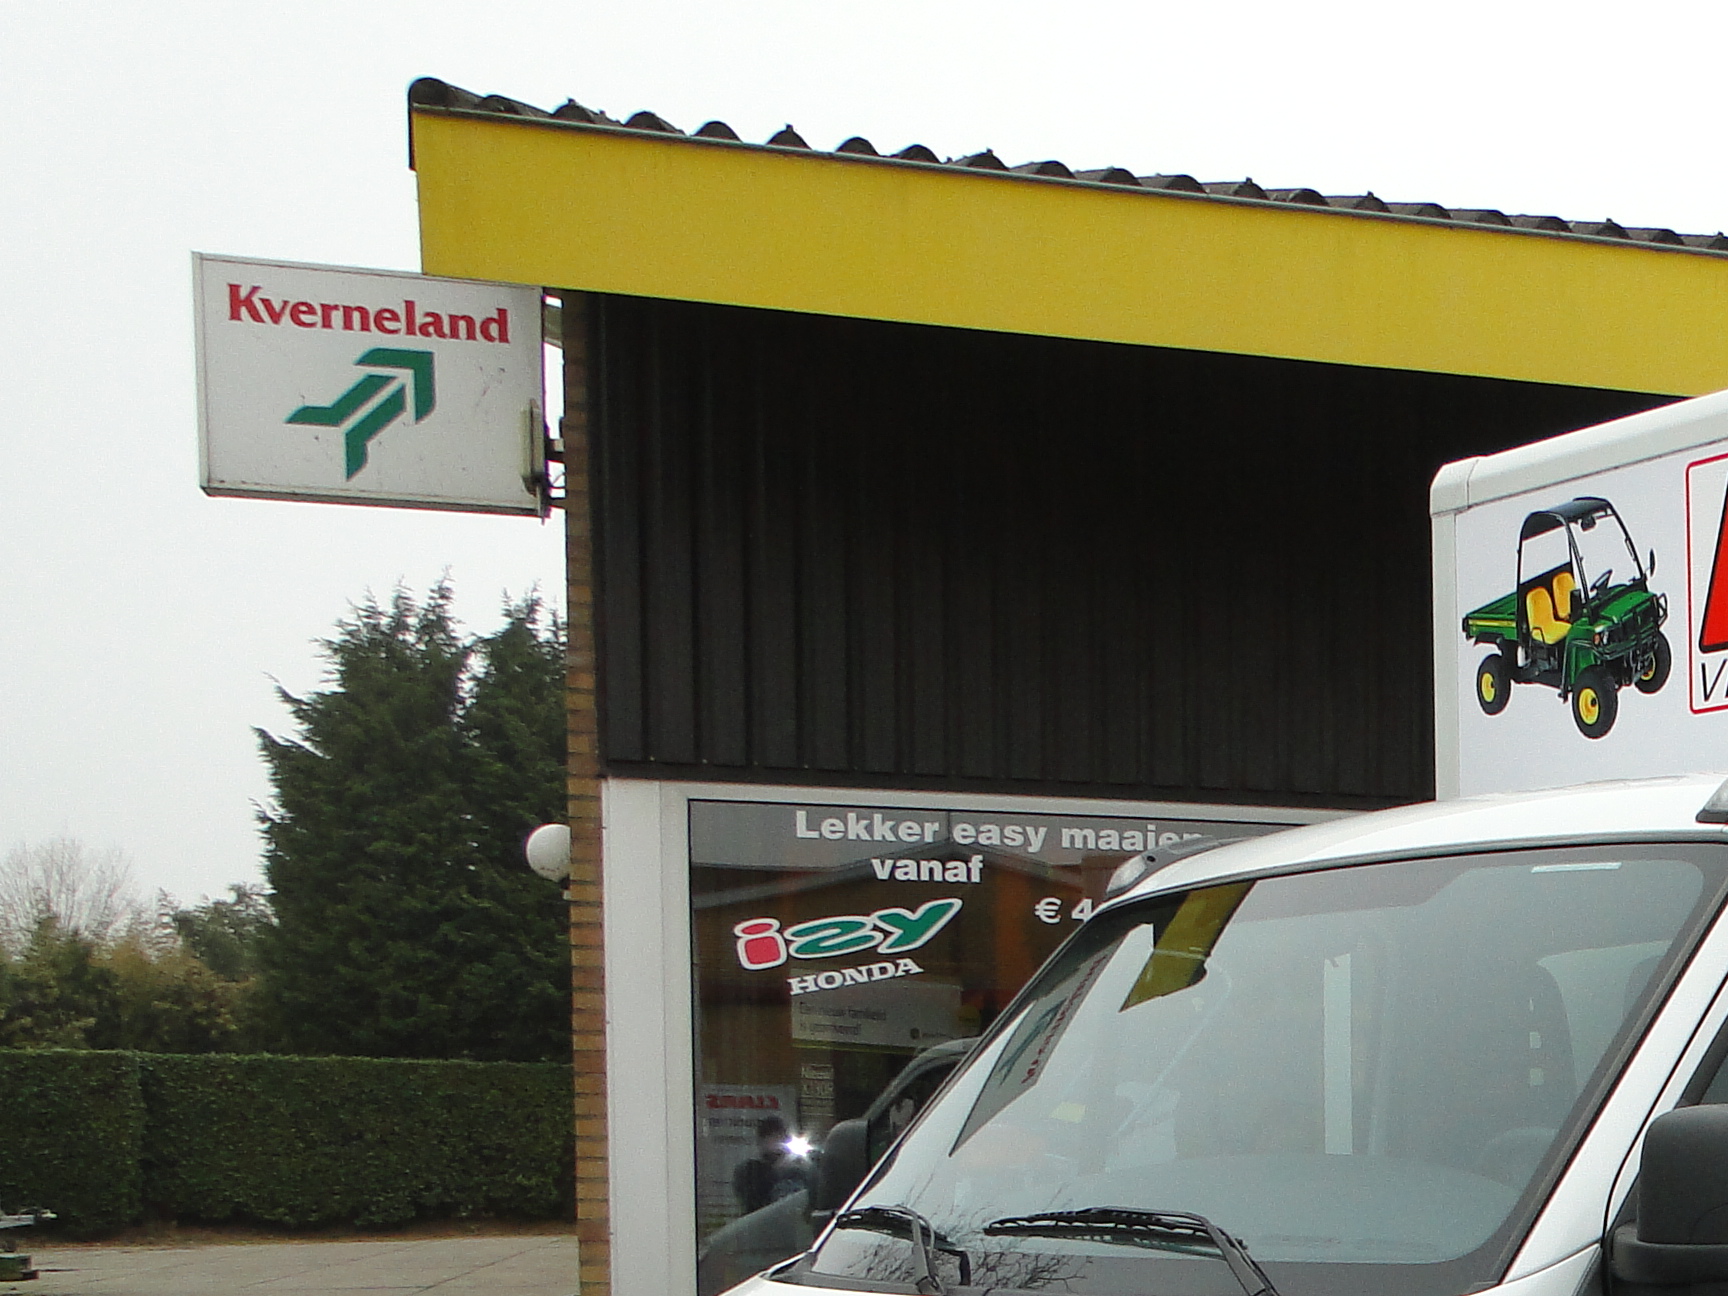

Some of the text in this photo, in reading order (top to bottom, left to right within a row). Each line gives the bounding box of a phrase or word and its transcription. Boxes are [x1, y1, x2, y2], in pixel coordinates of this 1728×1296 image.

[227, 283, 510, 344] Kverneland
[796, 810, 940, 843] Lekker
[952, 822, 1048, 853] easy
[871, 855, 984, 883] vanaf
[1034, 897, 1062, 924] €
[786, 957, 925, 996] HONDA
